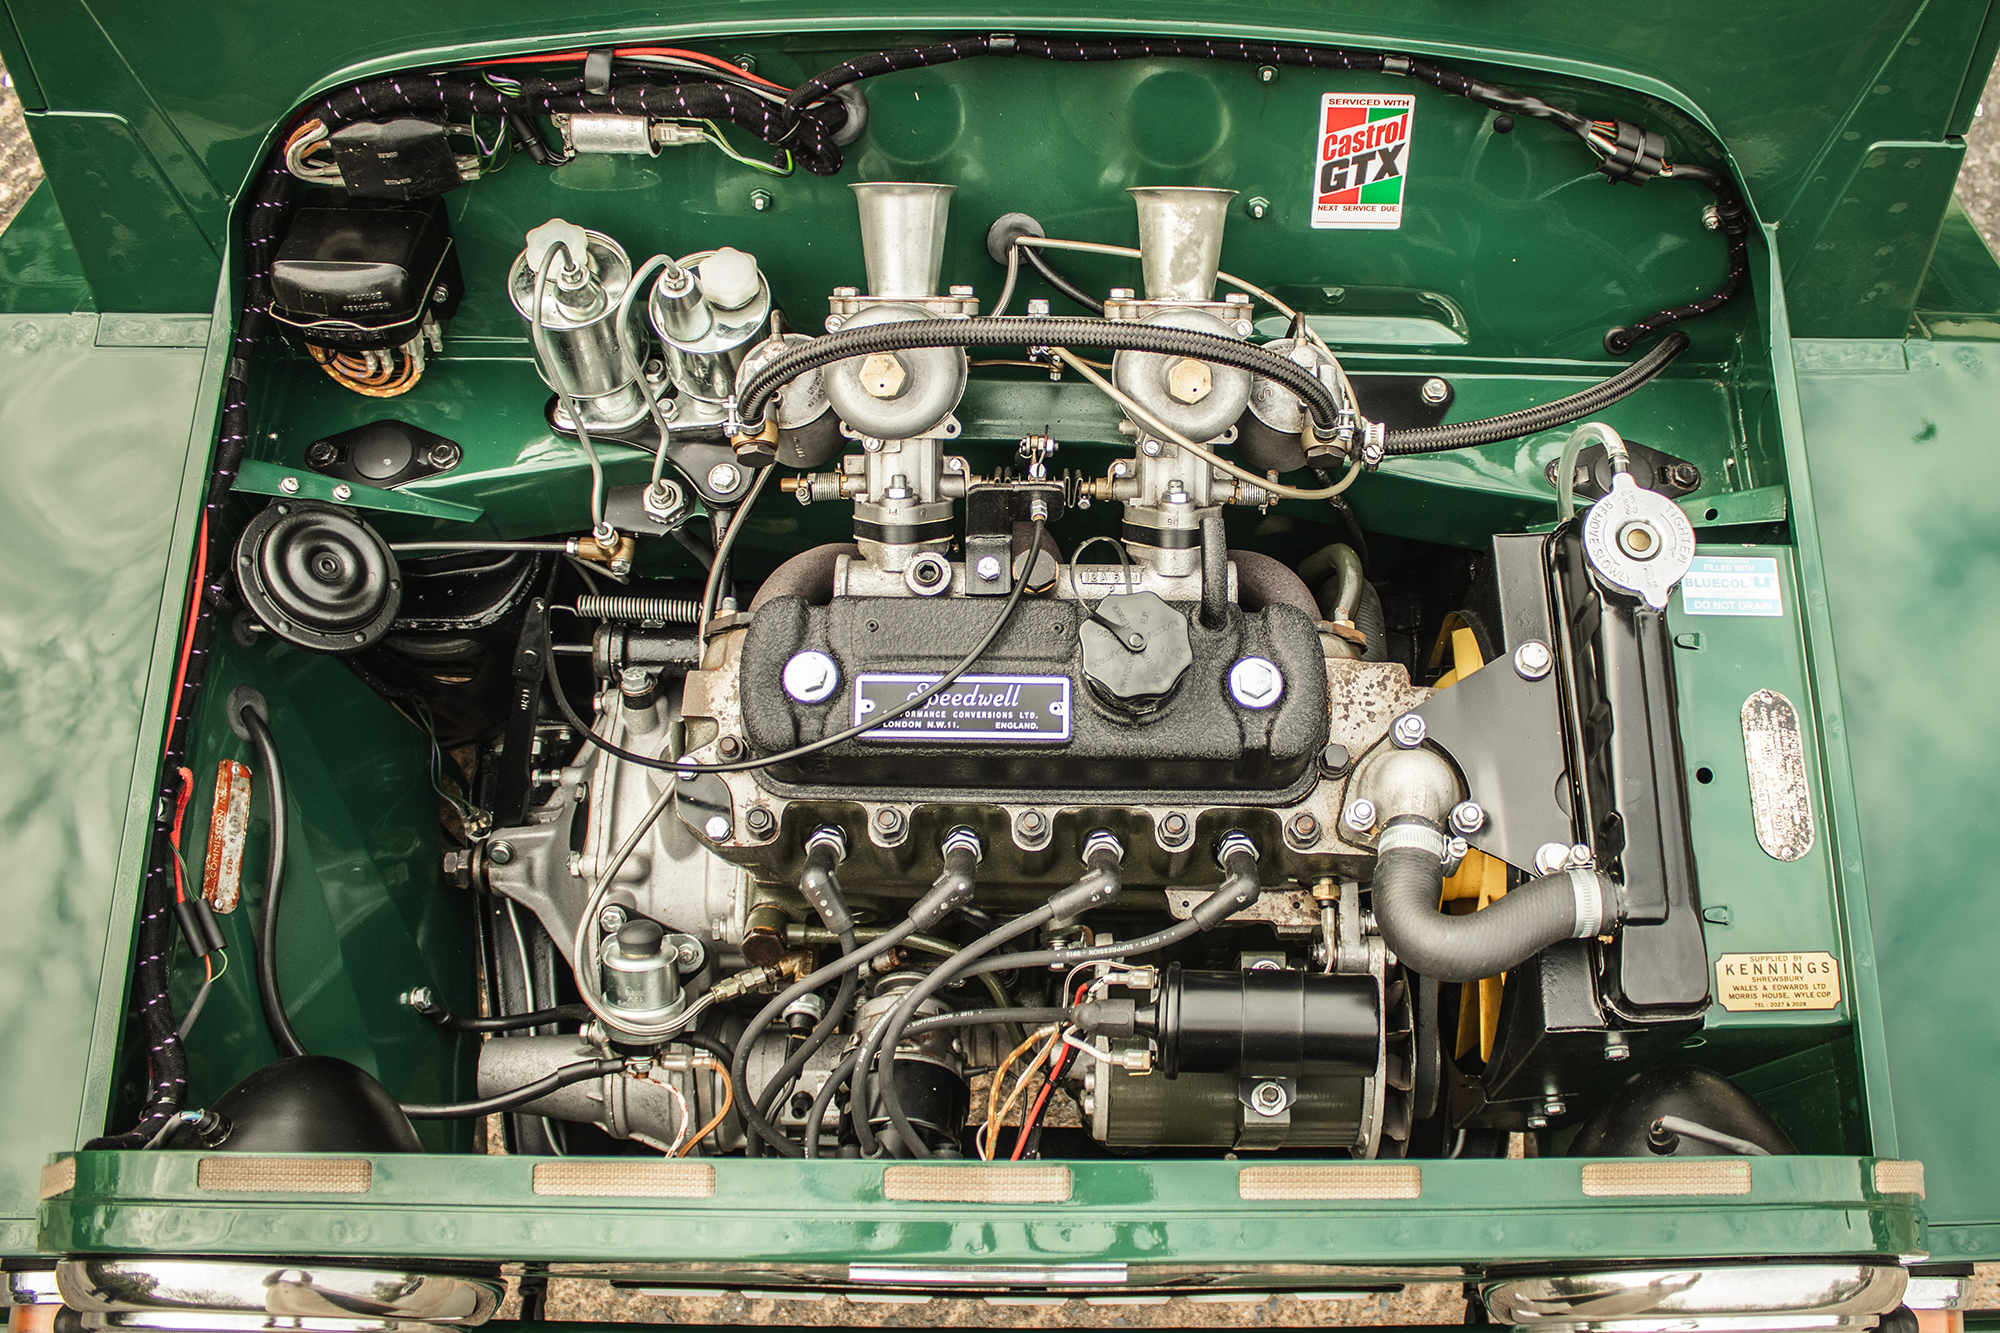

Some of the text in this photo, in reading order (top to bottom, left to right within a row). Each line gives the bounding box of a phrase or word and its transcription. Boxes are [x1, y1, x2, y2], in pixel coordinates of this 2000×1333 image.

[1328, 98, 1380, 106] SERVICED
[1322, 113, 1408, 161] Castrol
[1320, 142, 1406, 194] GTX
[1666, 504, 1691, 564] TIGHTEN
[1589, 500, 1634, 584] REMOVE SLOWLY
[1703, 564, 1755, 572] FILLED WITH
[1685, 578, 1748, 588] BLUECOL
[1694, 601, 1772, 610] DO NOT DRAIN
[1147, 618, 1180, 640] FILTRATE
[1090, 646, 1126, 668] CASTROL
[906, 682, 1022, 710] Speedwell
[953, 710, 1013, 719] CONVERSIONS
[883, 720, 1039, 730] LONDON N.W.11. ENGLAND.
[210, 808, 224, 878] COMMISSION
[1088, 944, 1134, 956] SUPPRESSION
[1725, 962, 1830, 976] KENNINGS
[912, 1013, 953, 1027] SUPPRESSION
